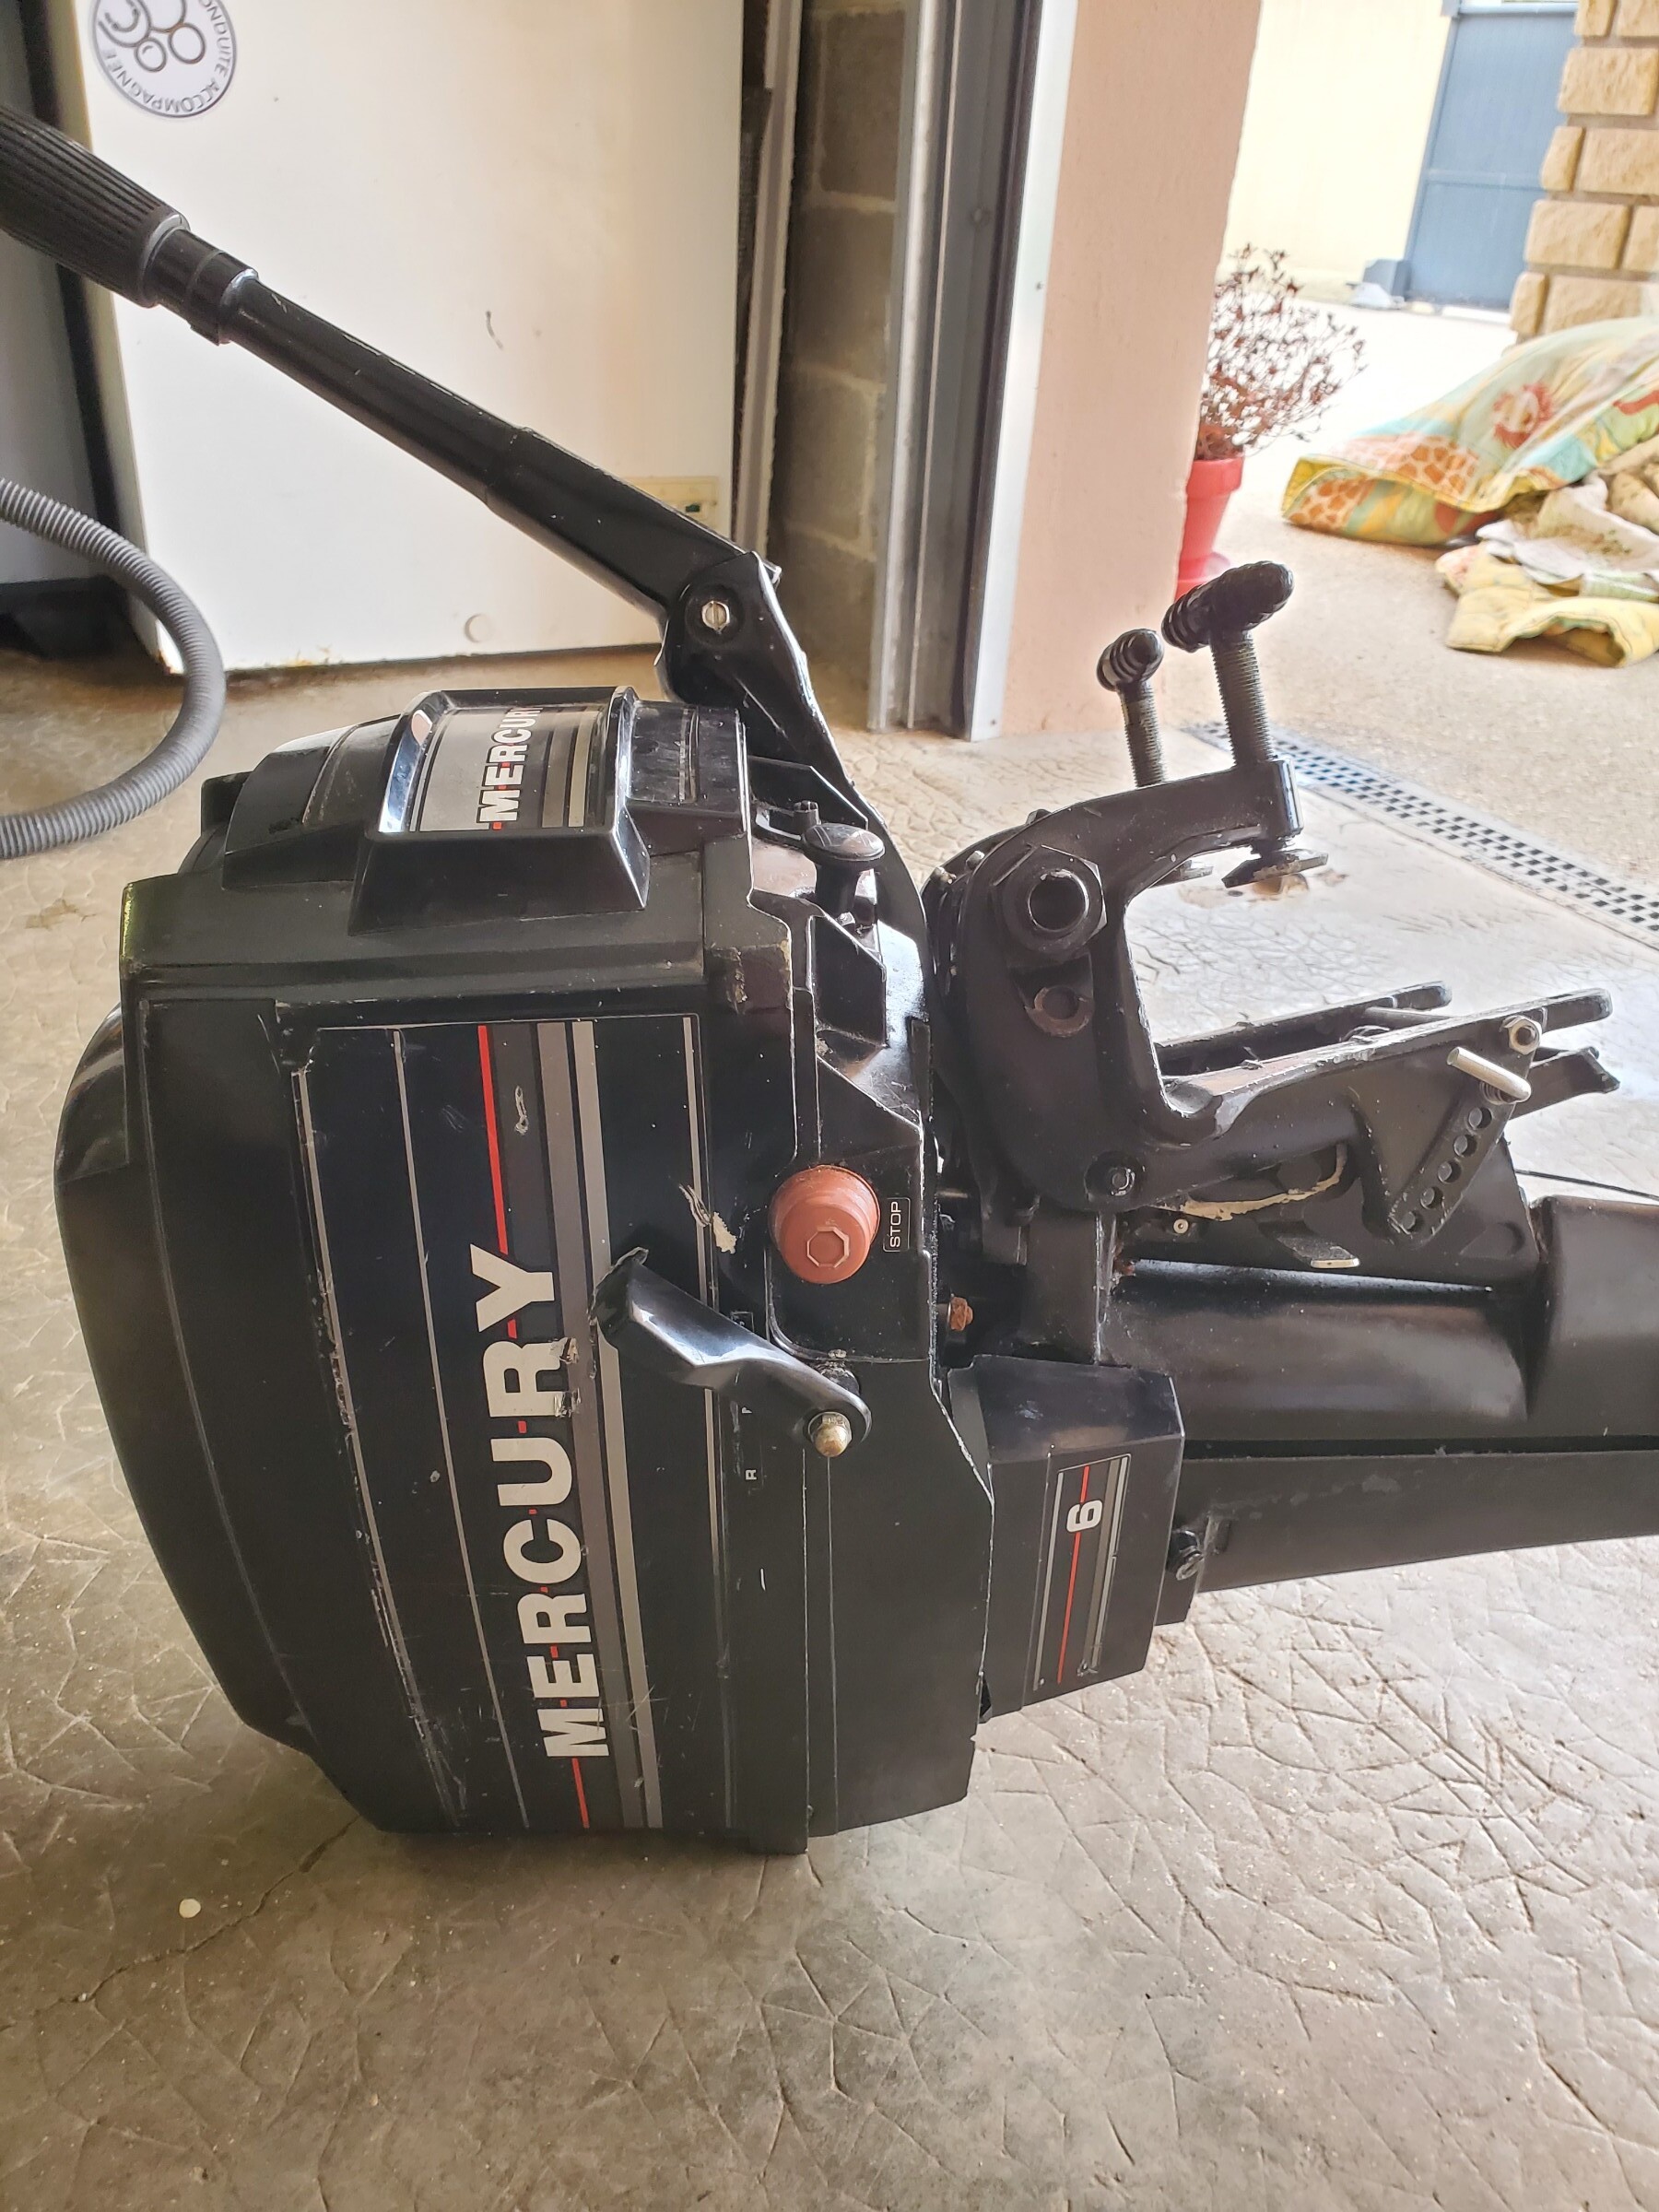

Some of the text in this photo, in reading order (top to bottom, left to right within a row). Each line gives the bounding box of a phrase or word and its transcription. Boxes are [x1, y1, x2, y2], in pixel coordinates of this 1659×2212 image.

[889, 1201, 902, 1248] STOP
[745, 1469, 757, 1480] R
[470, 1243, 610, 1758] MERCURY
[1066, 1500, 1103, 1533] 6
